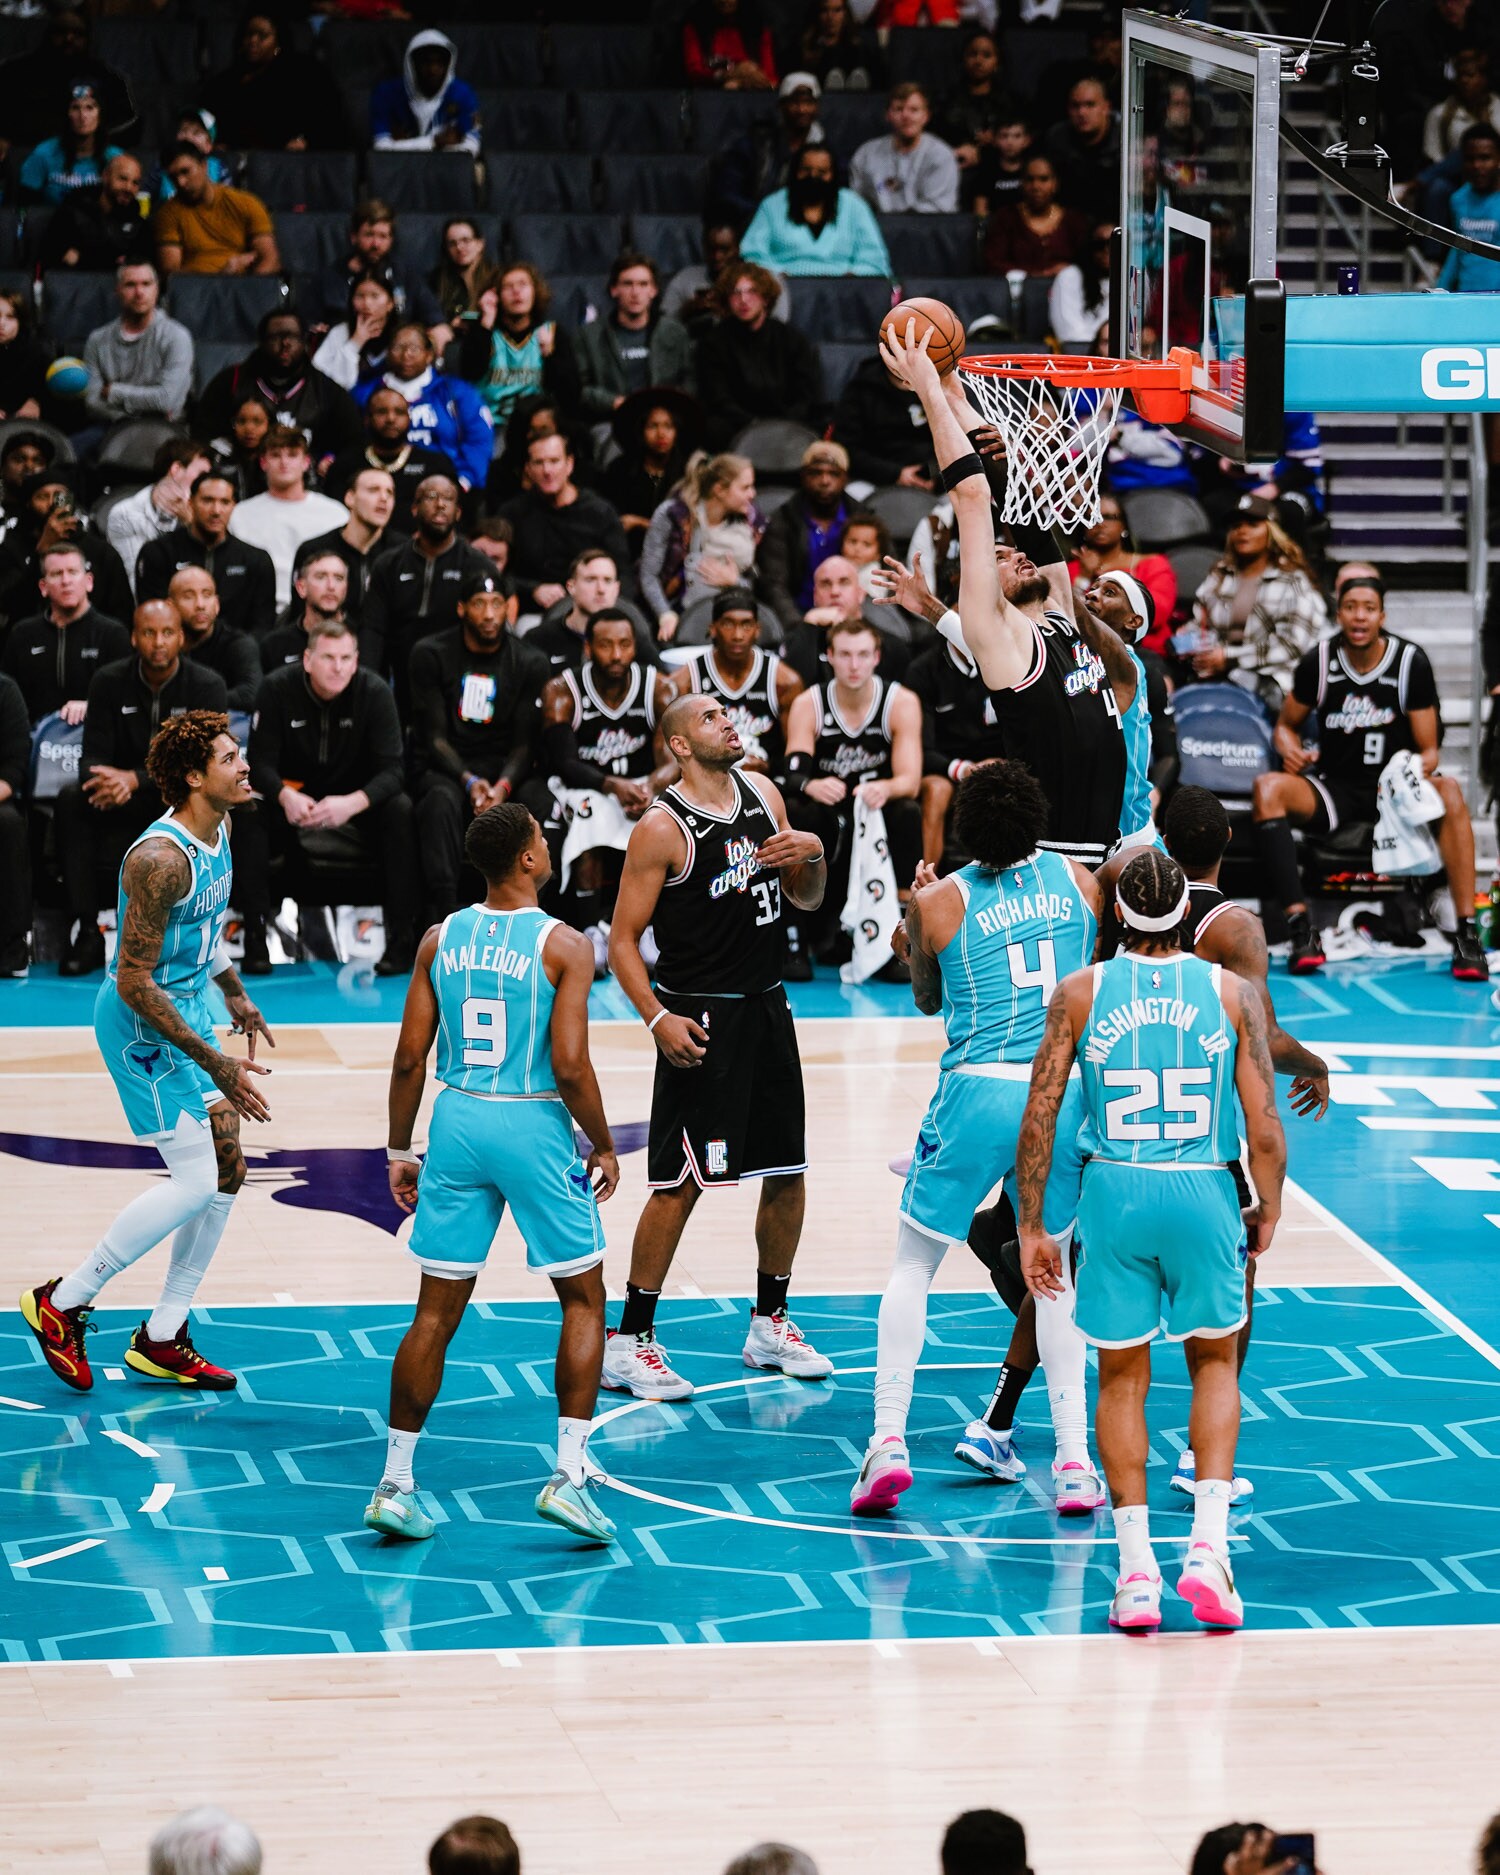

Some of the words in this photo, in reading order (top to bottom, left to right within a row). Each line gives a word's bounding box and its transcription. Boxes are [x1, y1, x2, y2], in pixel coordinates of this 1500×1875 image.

[1421, 347, 1500, 400] G
[1325, 706, 1395, 734] angeles
[1181, 737, 1258, 758] Spectrum
[1221, 757, 1258, 768] CENTER
[1363, 732, 1385, 765] 9
[612, 757, 628, 775] 11
[686, 815, 697, 827] 6
[743, 806, 764, 818] honey
[187, 845, 197, 858] 6
[726, 836, 754, 867] los
[751, 877, 781, 926] 33
[975, 893, 1073, 936] RICHARDS
[197, 909, 227, 965] 12
[442, 945, 532, 981] MALEDON
[1006, 939, 1058, 1007] 4
[461, 997, 507, 1068] 9
[1085, 997, 1199, 1065] WASHINGTON
[1198, 1028, 1231, 1062] JR.
[1103, 1067, 1211, 1140] 25
